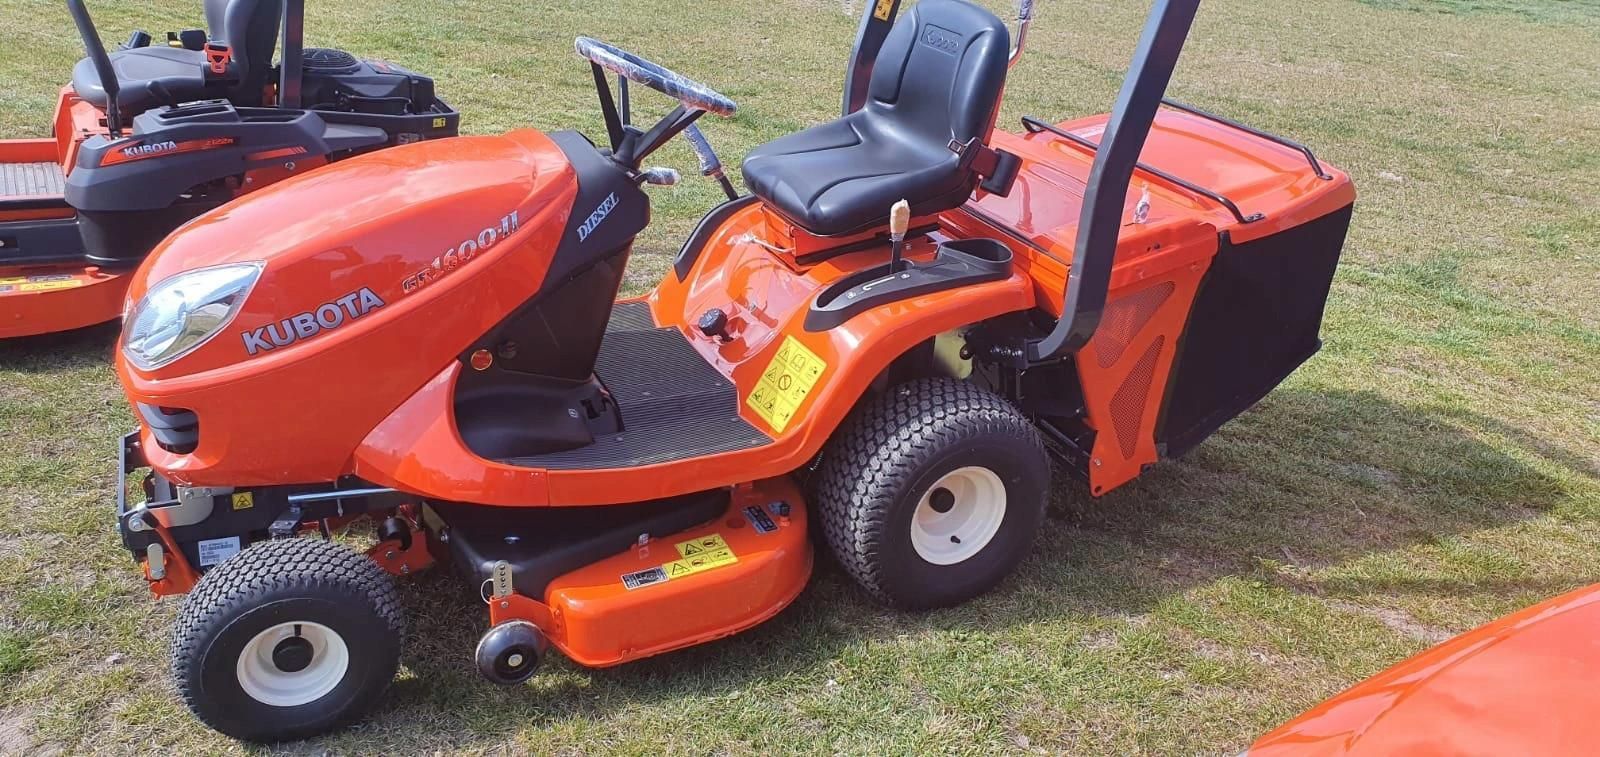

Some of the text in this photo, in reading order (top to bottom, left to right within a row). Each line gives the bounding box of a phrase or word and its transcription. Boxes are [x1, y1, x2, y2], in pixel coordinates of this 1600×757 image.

[124, 140, 177, 156] KUBOTA
[576, 191, 620, 243] DIESEL
[241, 287, 386, 355] KUBOTA
